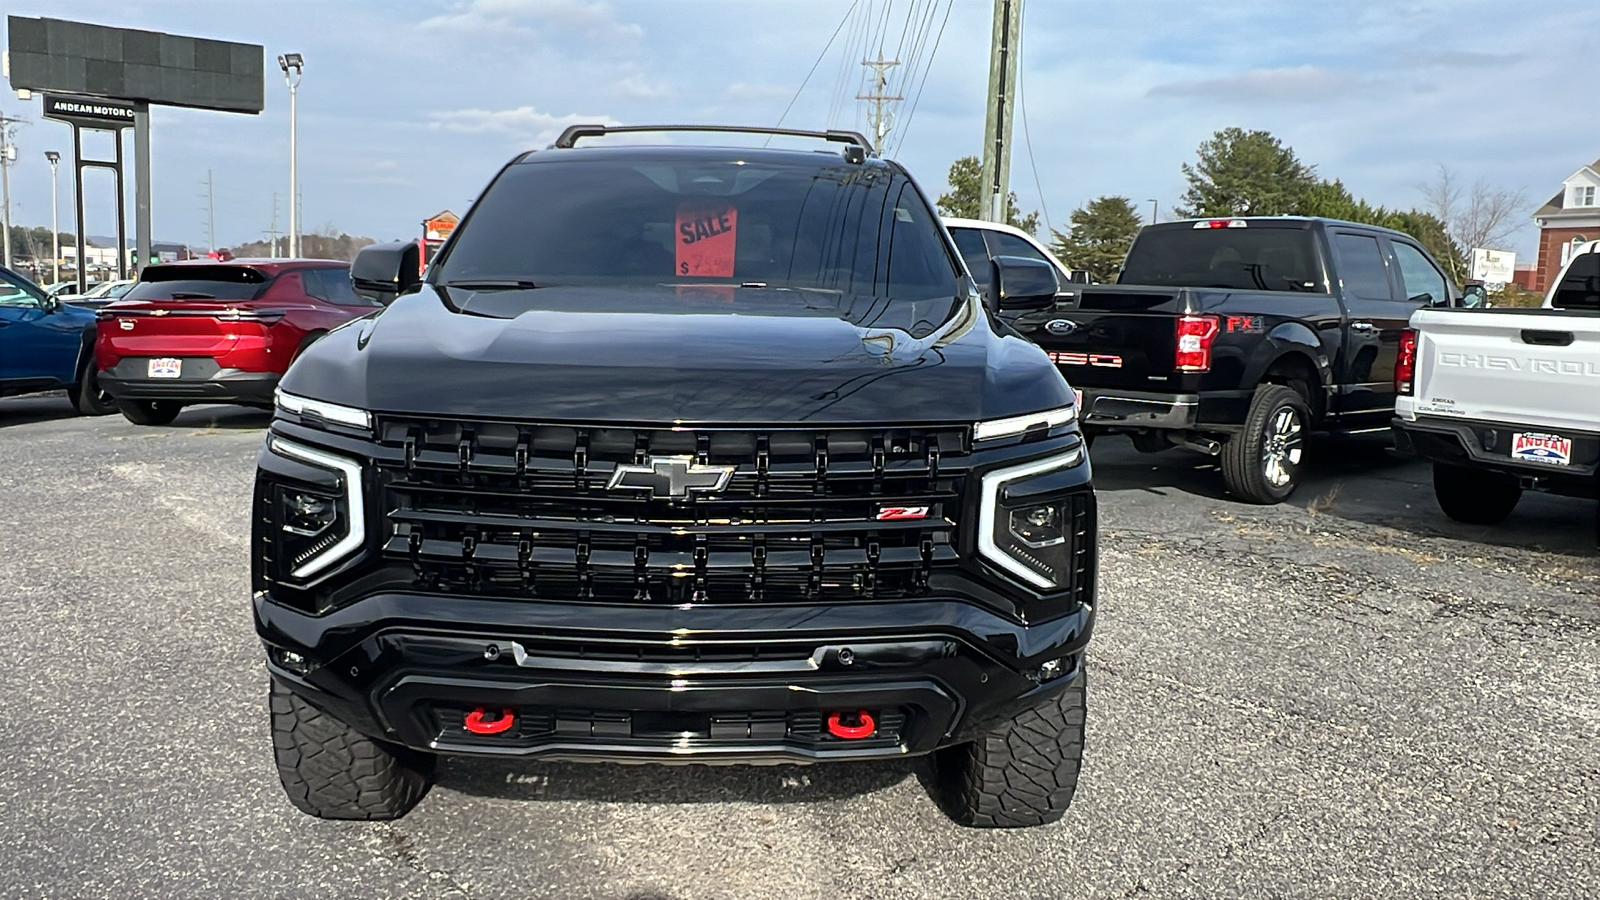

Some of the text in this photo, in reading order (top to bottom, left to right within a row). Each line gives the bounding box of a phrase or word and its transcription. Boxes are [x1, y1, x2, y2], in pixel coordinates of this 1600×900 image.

[53, 101, 135, 117] ANDEAN MOTOR C
[680, 211, 732, 244] SALE
[1226, 316, 1264, 333] FX4
[1418, 406, 1466, 415] COLORADO
[1515, 436, 1569, 457] ANDEAN
[875, 506, 929, 520] Z71
